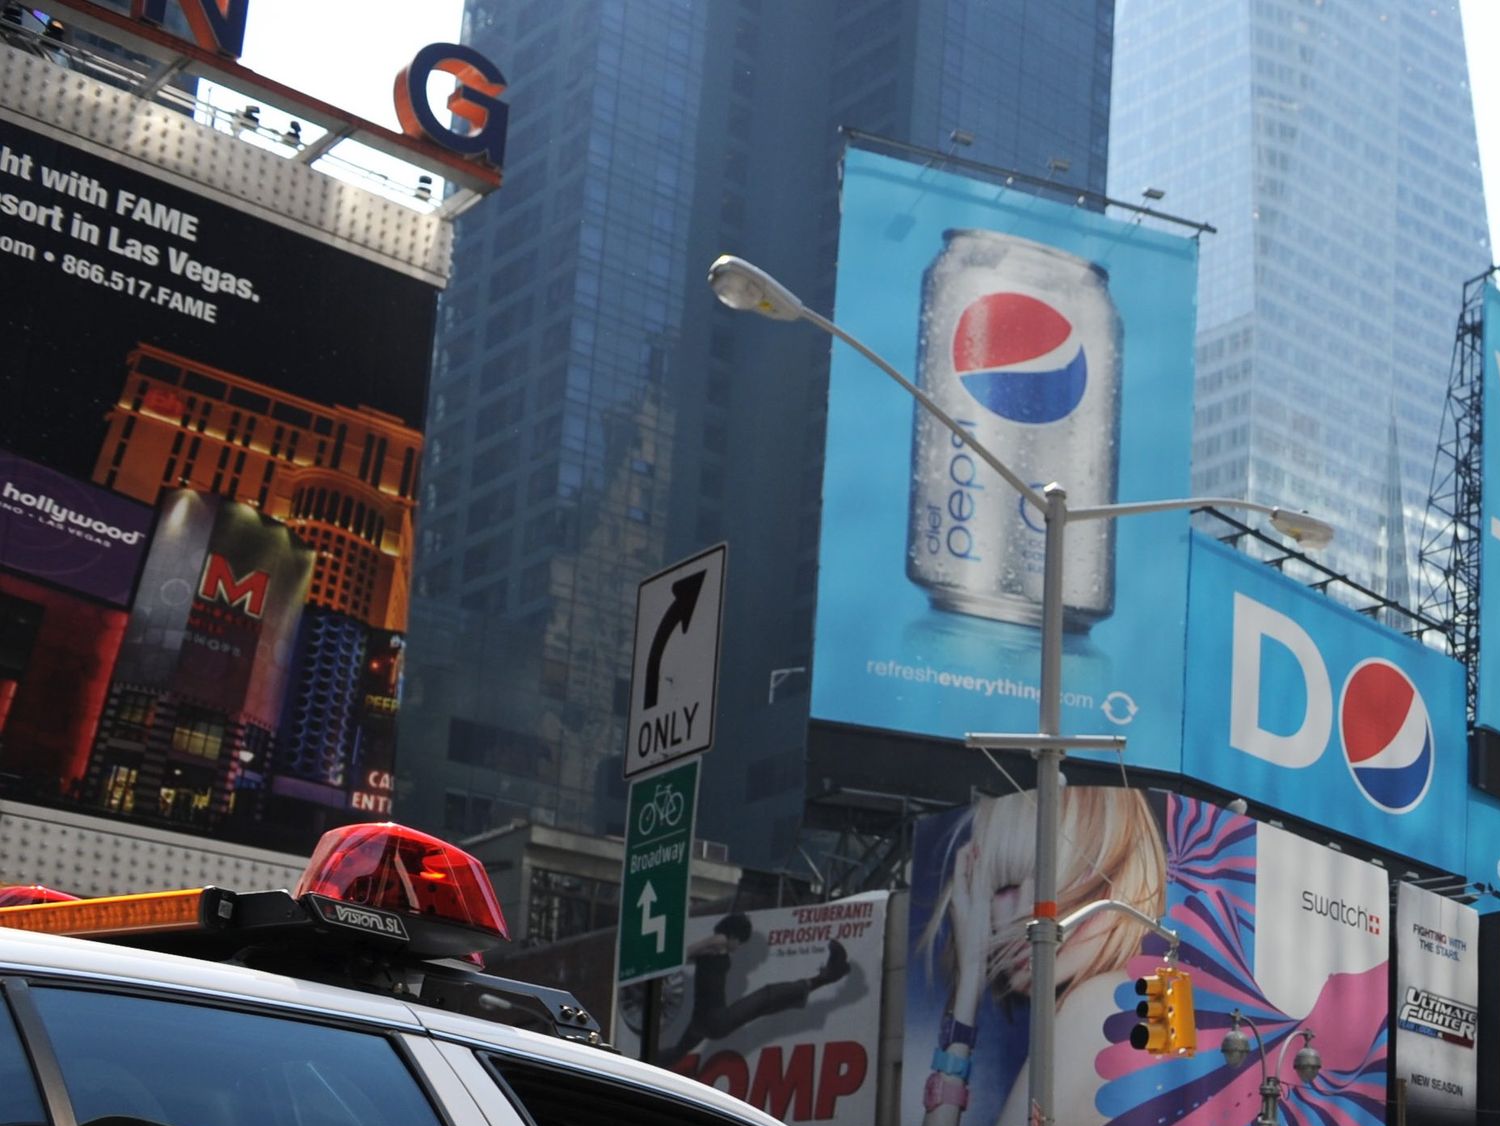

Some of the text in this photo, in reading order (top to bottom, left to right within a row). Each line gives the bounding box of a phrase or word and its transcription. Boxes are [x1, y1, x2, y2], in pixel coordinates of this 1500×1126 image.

[42, 162, 110, 208] with
[117, 189, 199, 243] FAME
[71, 212, 102, 247] in
[108, 226, 159, 268] Las
[167, 248, 260, 304] Vegas.
[62, 254, 218, 325] 866.517.FAME
[3, 481, 139, 545] hollywood
[39, 515, 64, 531] LAS
[68, 527, 111, 549] VEGAS
[926, 504, 943, 556] diet
[199, 552, 271, 619] M
[867, 660, 1093, 709] refresheverythincom
[637, 702, 700, 759] ONLY
[630, 840, 686, 875] Broadway
[1302, 890, 1368, 932] swatch
[768, 925, 832, 946] EXPLOSIVE
[1413, 923, 1467, 952] FIGHTING WITH
[1420, 938, 1434, 953] THE
[1400, 1004, 1475, 1042] FIGHTER
[1407, 987, 1477, 1023] ULTIMATE
[671, 1040, 868, 1122] OMP
[1411, 1073, 1463, 1097] NEW SEASON
